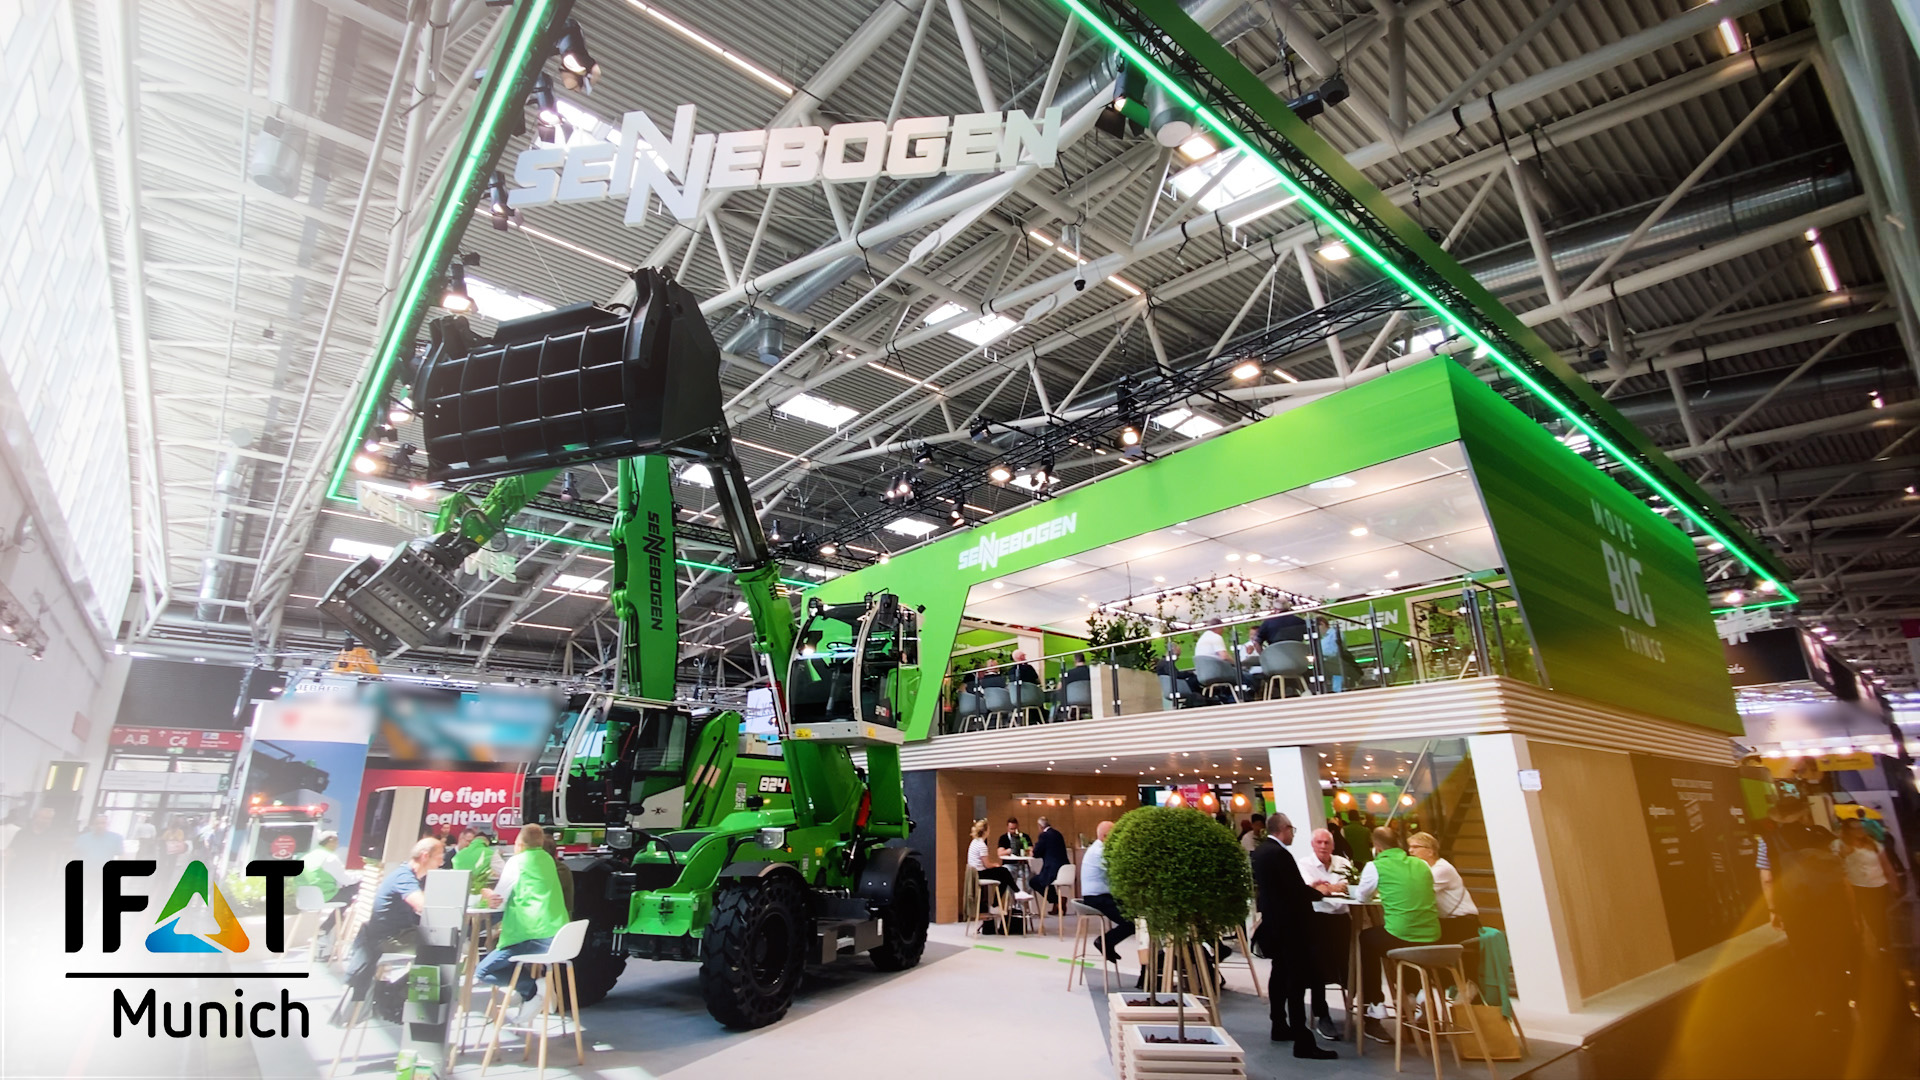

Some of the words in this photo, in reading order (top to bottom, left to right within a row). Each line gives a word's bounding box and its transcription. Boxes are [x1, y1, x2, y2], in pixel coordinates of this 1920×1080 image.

[507, 104, 1063, 227] SENNEBOGEN
[958, 512, 1077, 571] SENNEBOGEN
[1590, 498, 1637, 549] MOVE
[642, 510, 666, 631] SENNEBOGEN
[1600, 539, 1656, 627] BIG
[1619, 626, 1666, 663] THINGS
[169, 736, 188, 747] C4
[456, 786, 507, 808] fight
